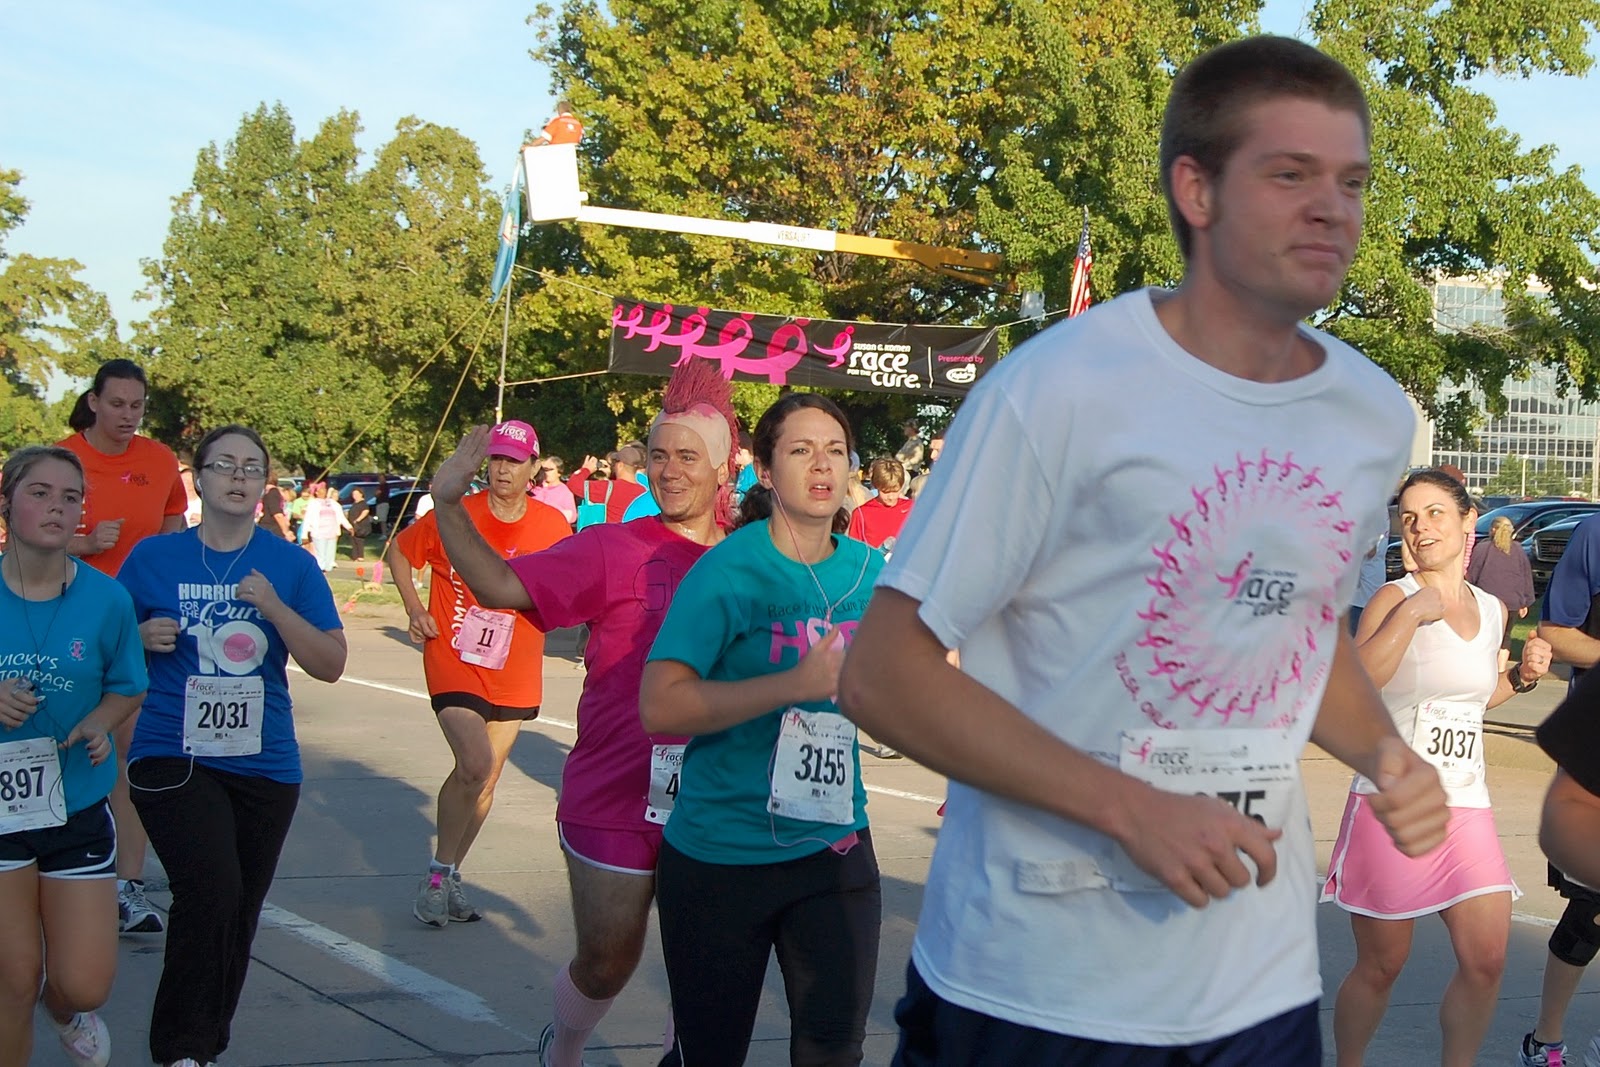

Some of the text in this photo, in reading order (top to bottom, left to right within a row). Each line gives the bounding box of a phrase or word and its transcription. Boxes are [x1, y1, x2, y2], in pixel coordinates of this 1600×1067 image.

[938, 355, 984, 364] Presented by
[178, 583, 239, 601] HURRIC
[180, 601, 199, 618] FOR THE
[768, 603, 800, 619] Race
[477, 627, 495, 648] 11
[198, 701, 249, 729] 2031
[1427, 726, 1476, 760] 3037
[794, 743, 846, 787] 3155
[0, 765, 45, 802] 897
